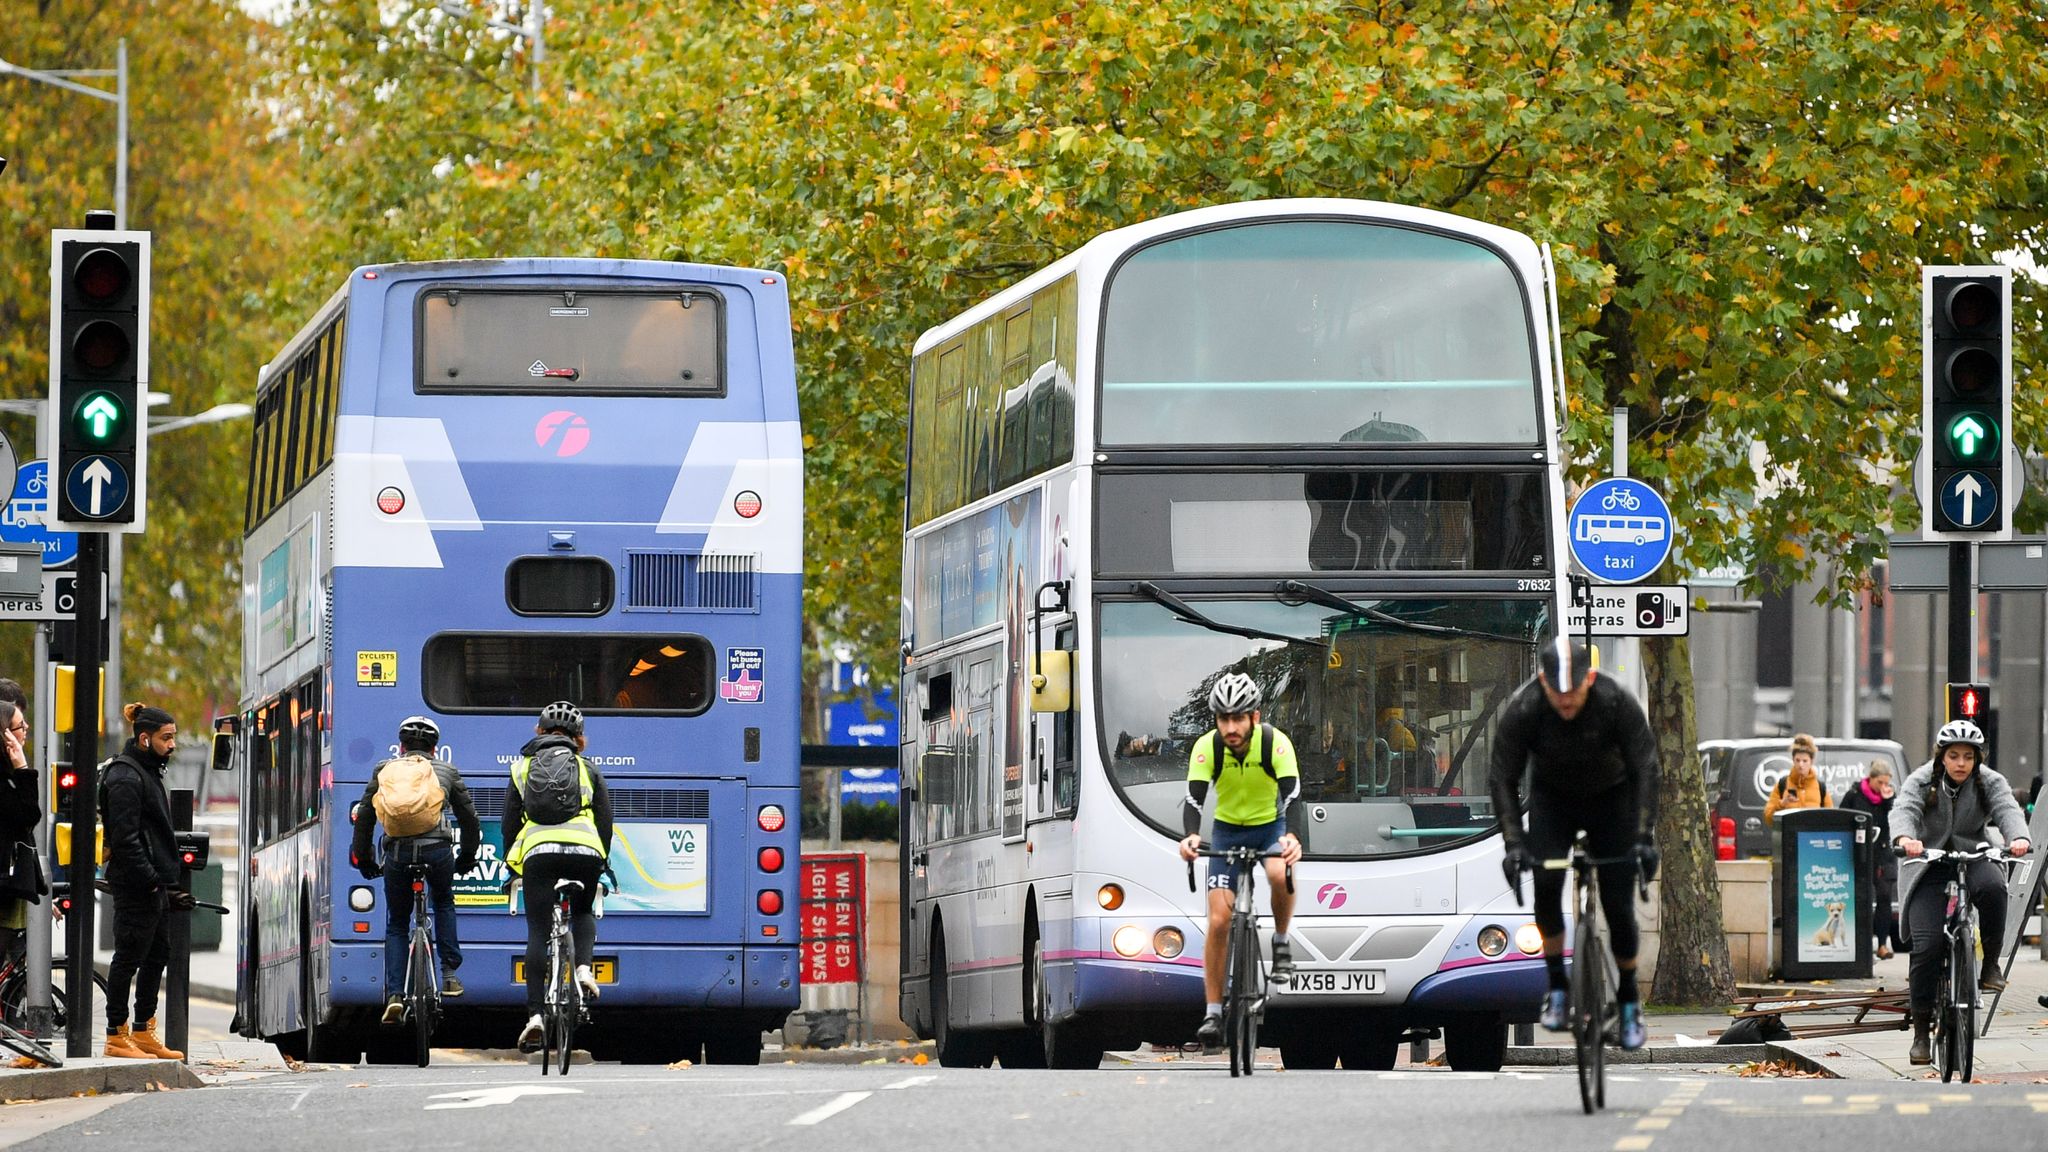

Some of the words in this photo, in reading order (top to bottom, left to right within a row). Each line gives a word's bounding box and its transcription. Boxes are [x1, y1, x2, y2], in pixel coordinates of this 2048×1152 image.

[1604, 554, 1635, 569] taxi
[1517, 580, 1551, 591] 37632
[1816, 763, 1865, 781] ryant
[812, 863, 827, 911] IGHT
[1290, 974, 1335, 991] WX58
[1341, 974, 1376, 991] JYU
